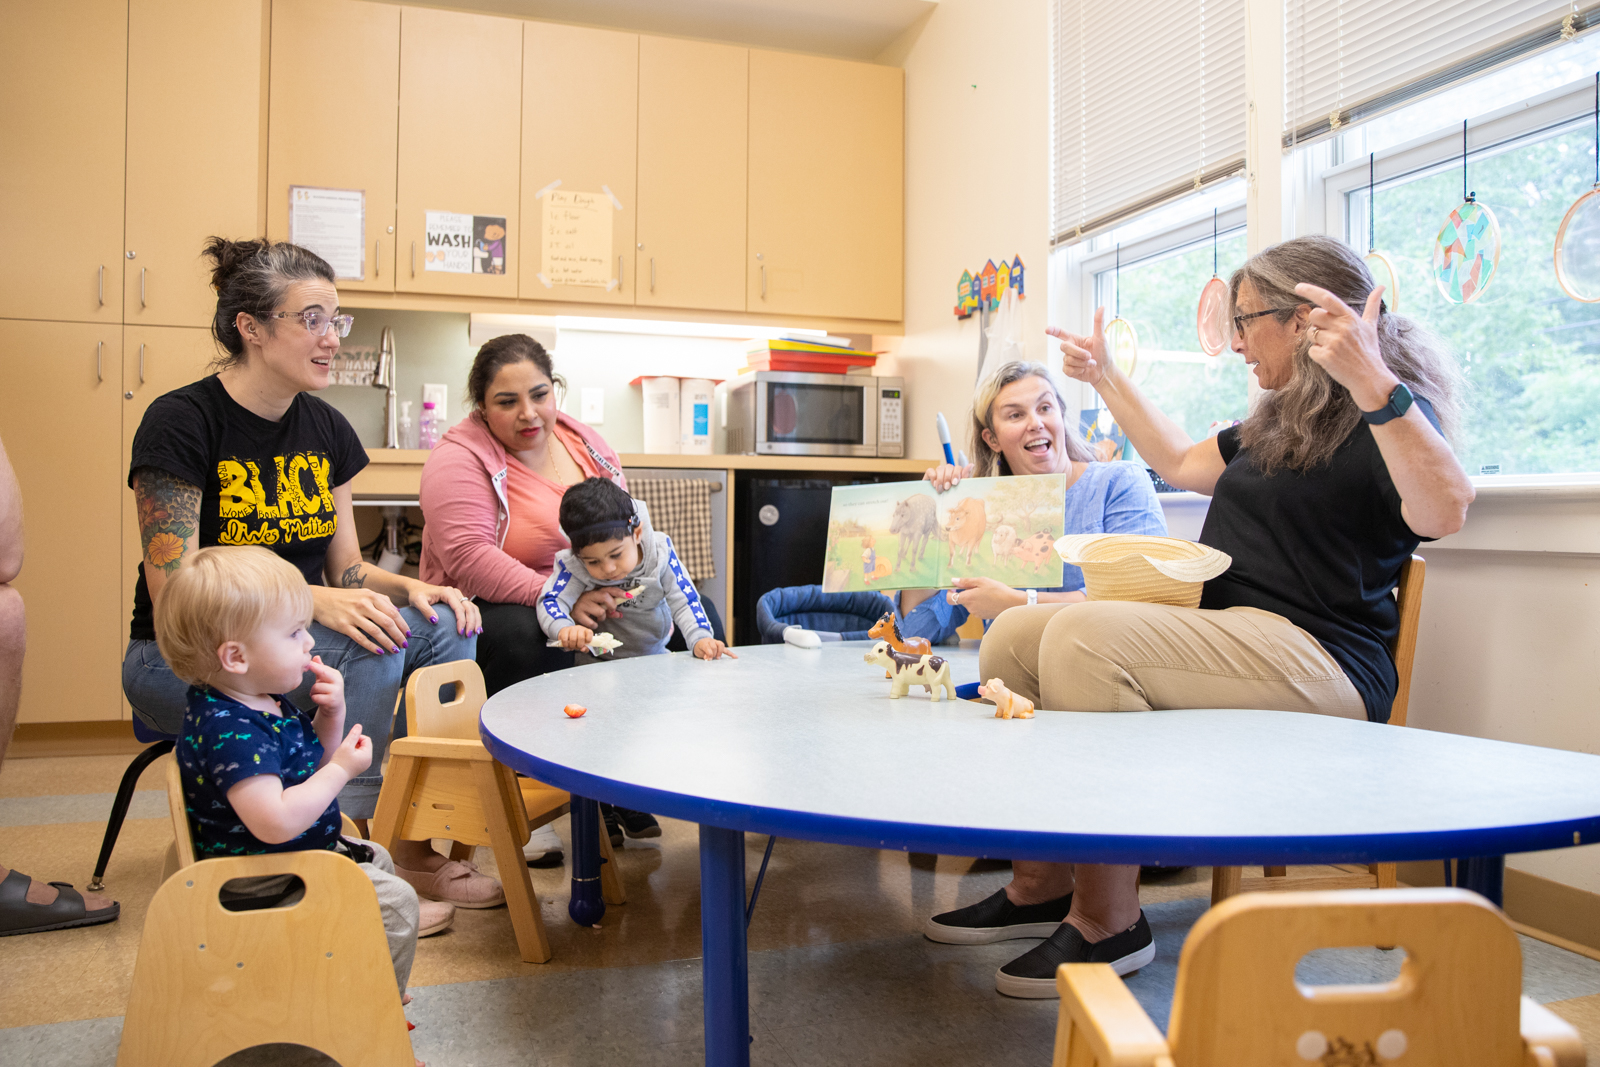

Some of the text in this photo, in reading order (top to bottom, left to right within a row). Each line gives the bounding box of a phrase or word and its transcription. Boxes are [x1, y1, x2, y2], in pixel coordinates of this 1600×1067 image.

[427, 232, 471, 248] WASH
[218, 463, 231, 489] TRANS
[217, 455, 334, 519] BLACK
[221, 502, 257, 518] WOMEN
